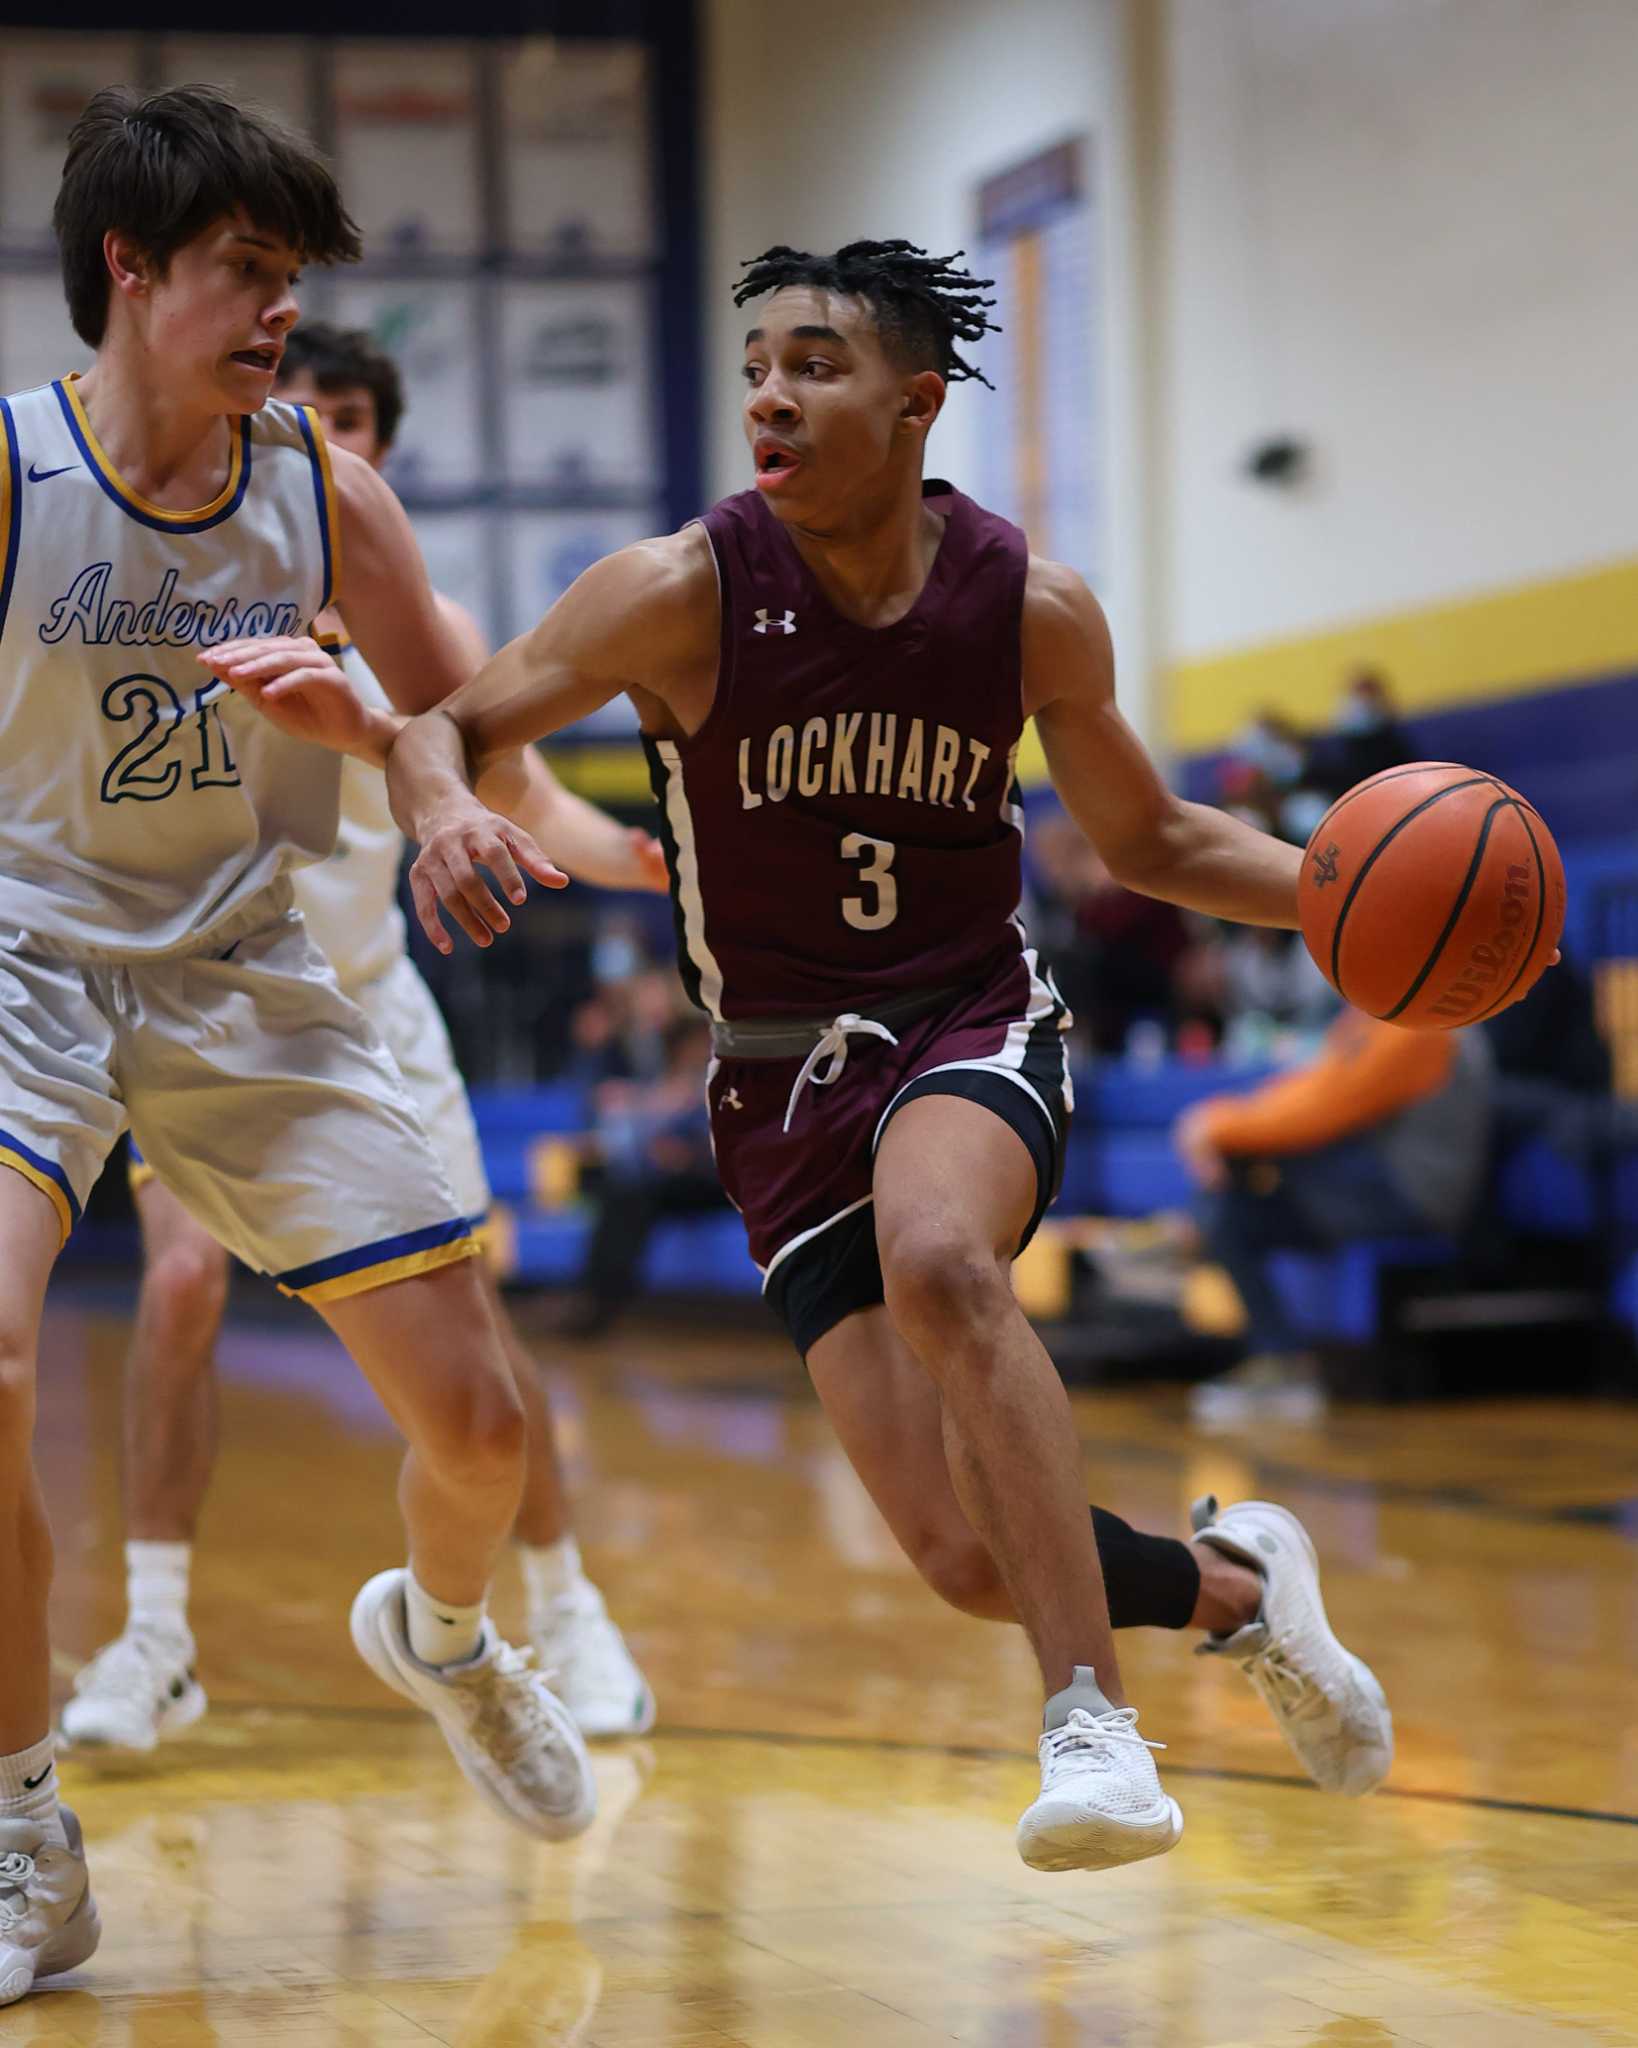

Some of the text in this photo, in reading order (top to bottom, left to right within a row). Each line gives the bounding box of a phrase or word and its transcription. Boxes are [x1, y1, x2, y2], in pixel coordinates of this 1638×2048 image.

[38, 561, 302, 648] Anderson
[100, 672, 242, 803] 21
[738, 711, 991, 812] LOCKHART
[840, 831, 899, 932] 3
[1425, 863, 1531, 1018] Wilson
